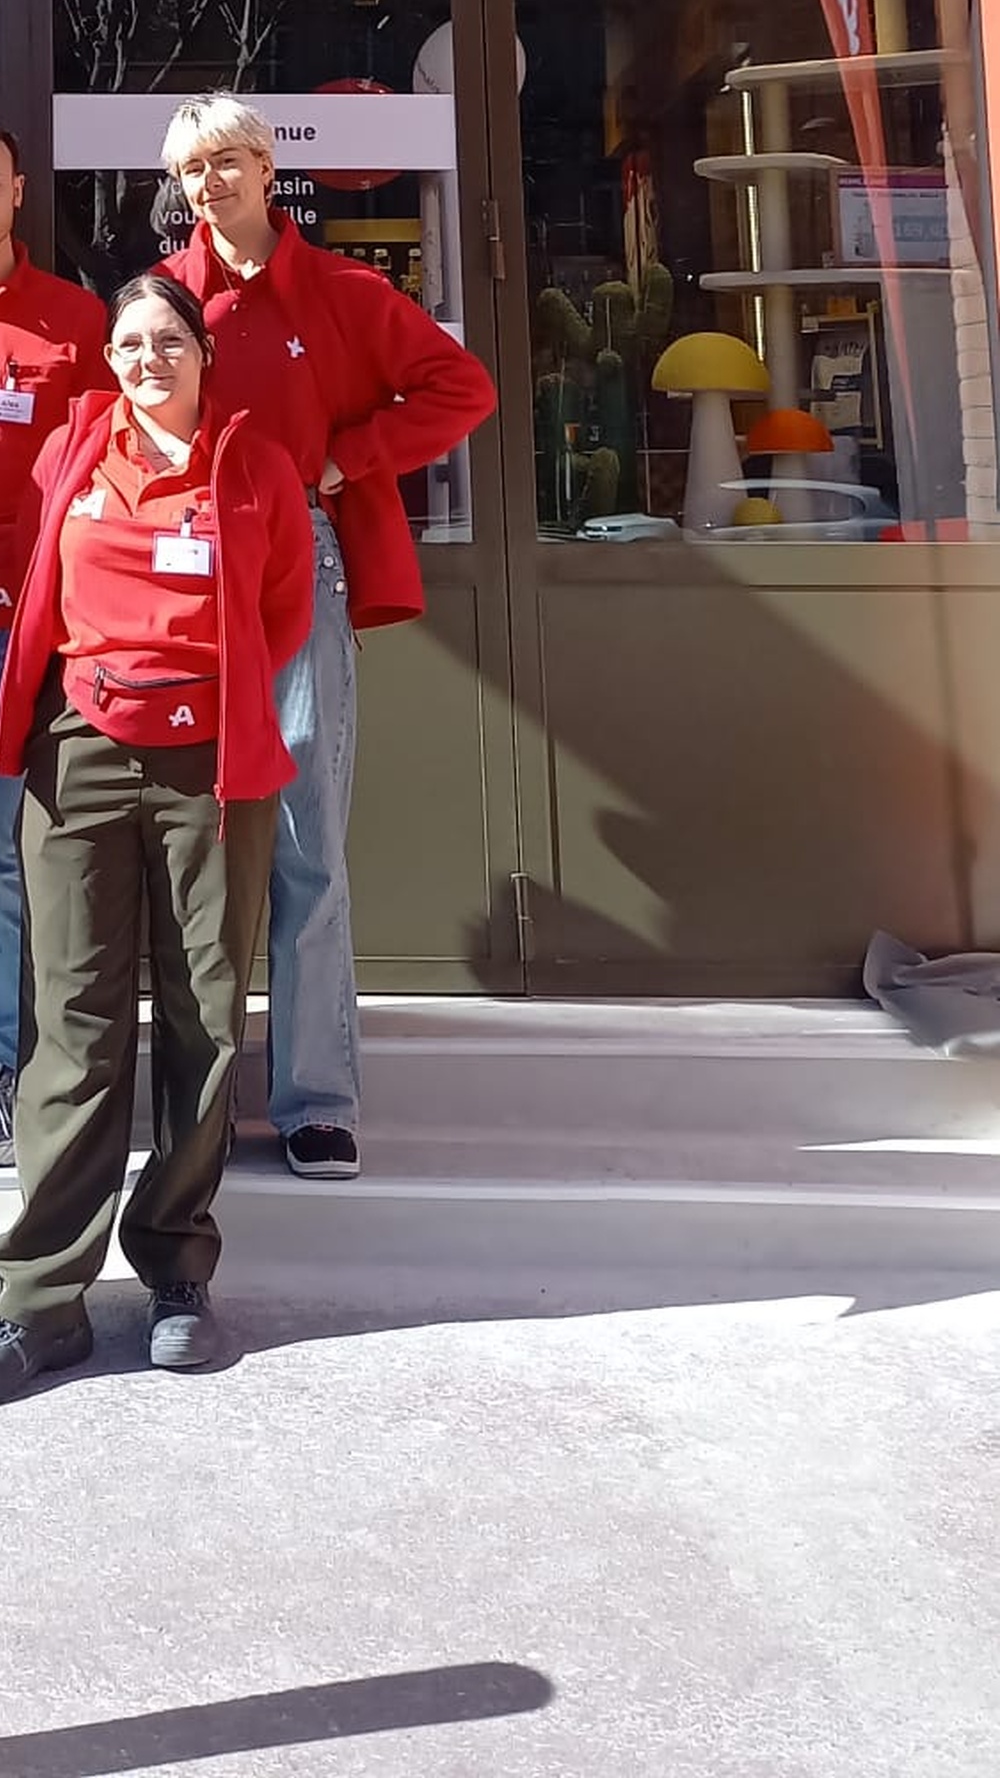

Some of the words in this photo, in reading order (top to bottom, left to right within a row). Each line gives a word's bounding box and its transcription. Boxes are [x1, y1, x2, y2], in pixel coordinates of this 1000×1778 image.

[272, 176, 315, 196] asin
[158, 209, 197, 225] vou
[168, 704, 196, 728] A
